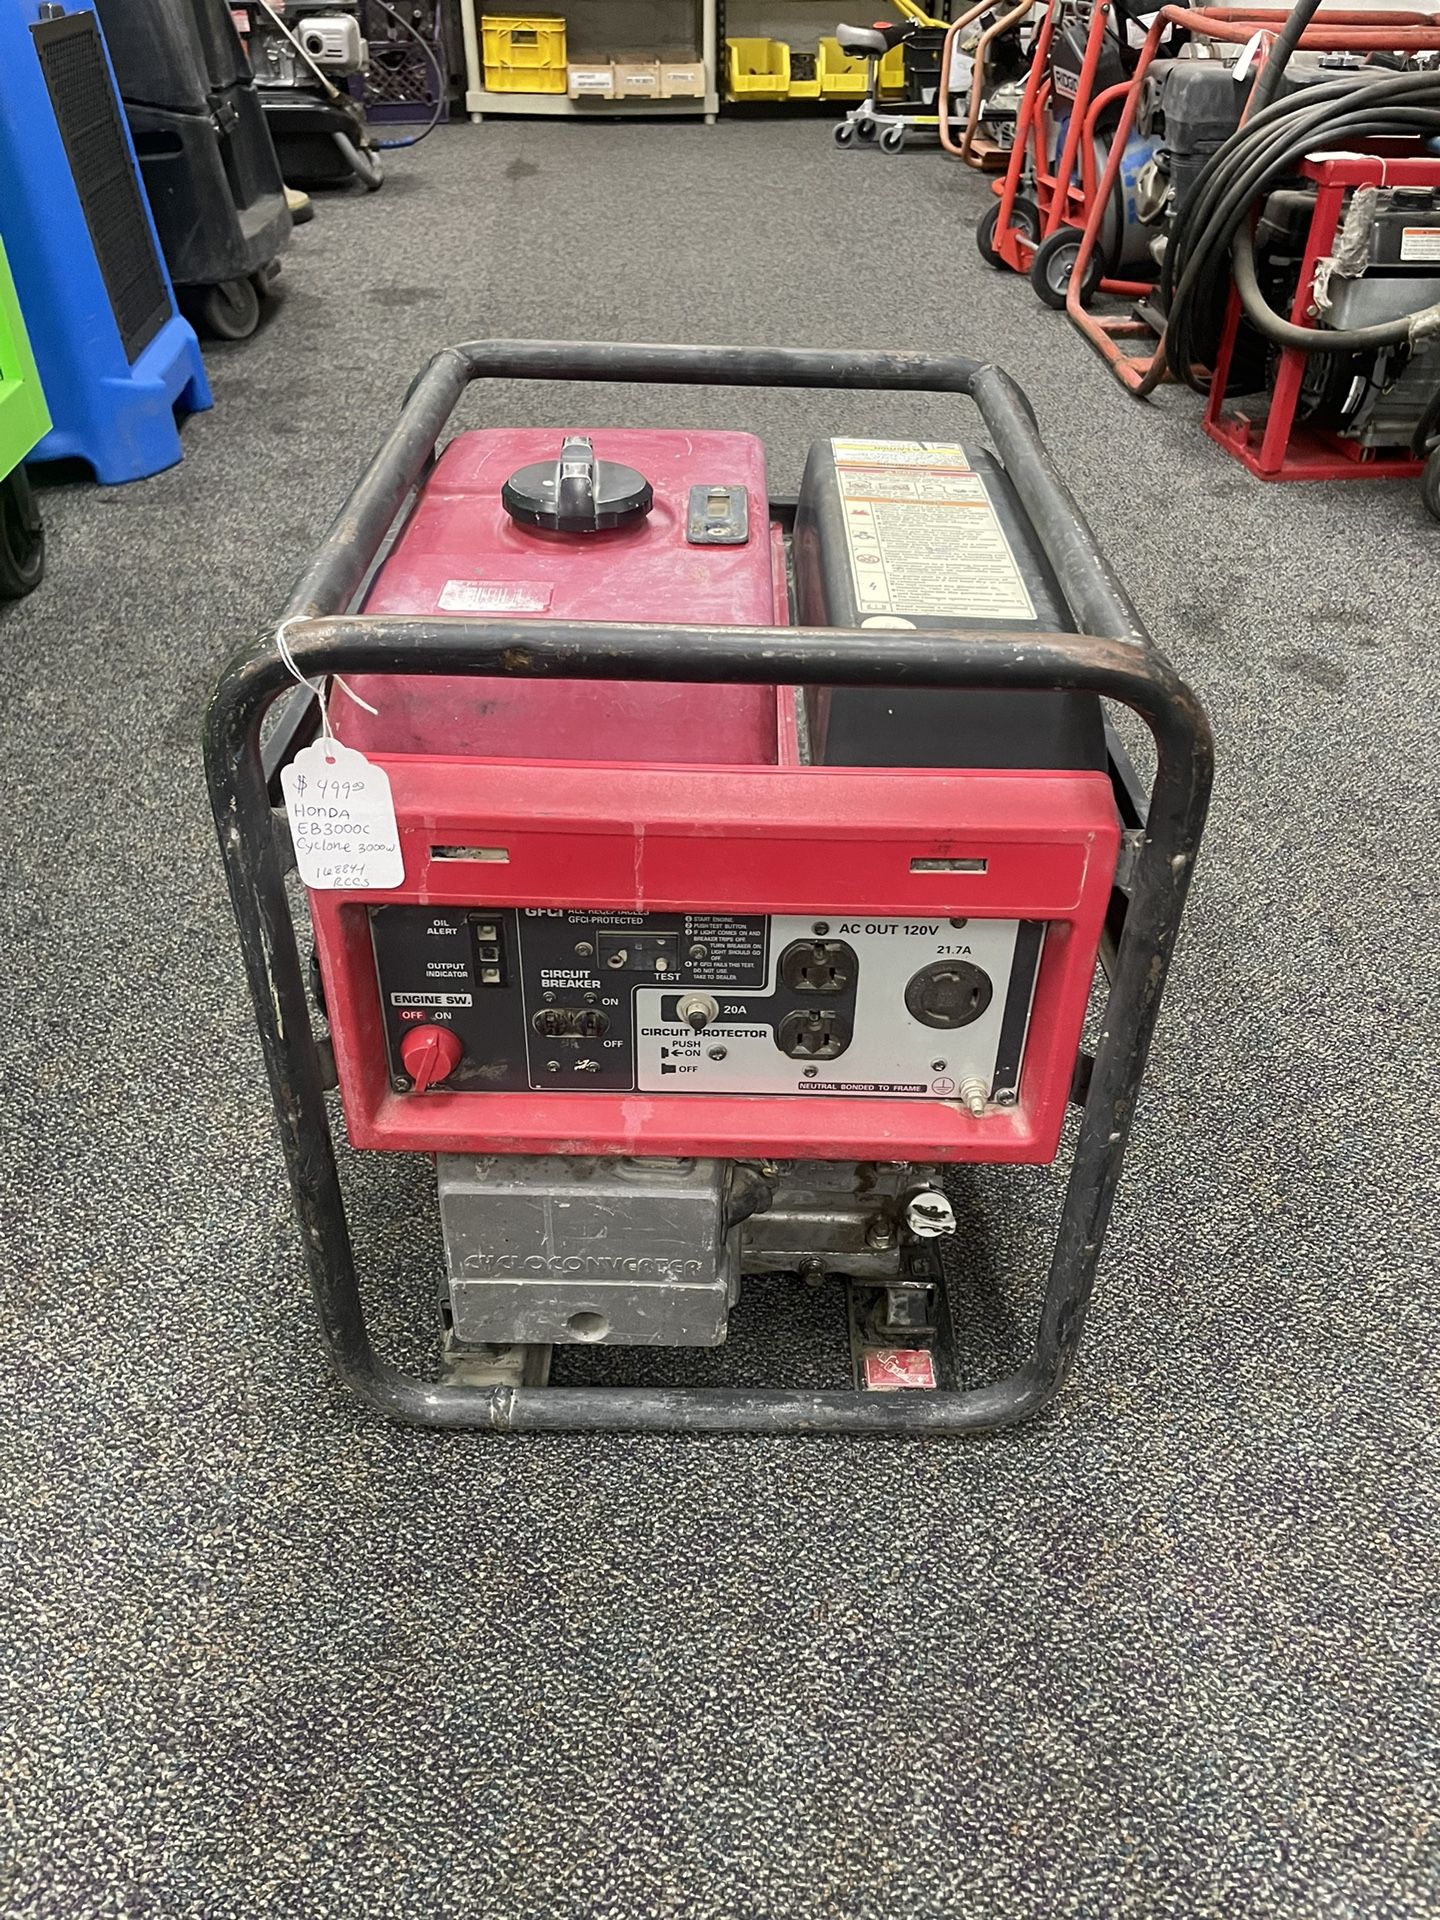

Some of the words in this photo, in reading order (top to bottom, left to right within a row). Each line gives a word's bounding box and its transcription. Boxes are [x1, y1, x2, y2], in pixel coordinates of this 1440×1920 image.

[293, 775, 308, 797] $
[296, 837, 351, 854] Cyclone
[433, 919, 450, 927] OIL
[568, 915, 643, 925] GFCI-PROTECTED
[426, 927, 458, 935] ALERT
[839, 924, 861, 934] AC
[865, 924, 899, 935] OUT
[903, 925, 940, 936] 120V
[936, 945, 972, 955] 21.7A
[426, 962, 465, 970] OUTPUT
[425, 970, 469, 978] INDICATOR
[540, 970, 591, 979] CIRCUIT
[654, 972, 682, 981] TEST
[541, 979, 601, 989] BREAKER
[394, 995, 442, 1004] ENGINE
[446, 996, 471, 1005] SW.
[602, 998, 619, 1006] ON
[723, 1005, 747, 1014] 20A
[402, 1011, 423, 1019] OFF
[434, 1011, 452, 1020] ON
[641, 1028, 690, 1037] CIRCUIT
[694, 1029, 767, 1038] PROTECTOR
[603, 1040, 624, 1048] OFF
[672, 1040, 701, 1048] PUSH
[684, 1049, 701, 1057] ON
[678, 1065, 698, 1073] OFF
[799, 1082, 837, 1090] NEUTRAL
[840, 1083, 875, 1091] BONDED
[463, 1254, 703, 1275] CYCLOCONVERTER
